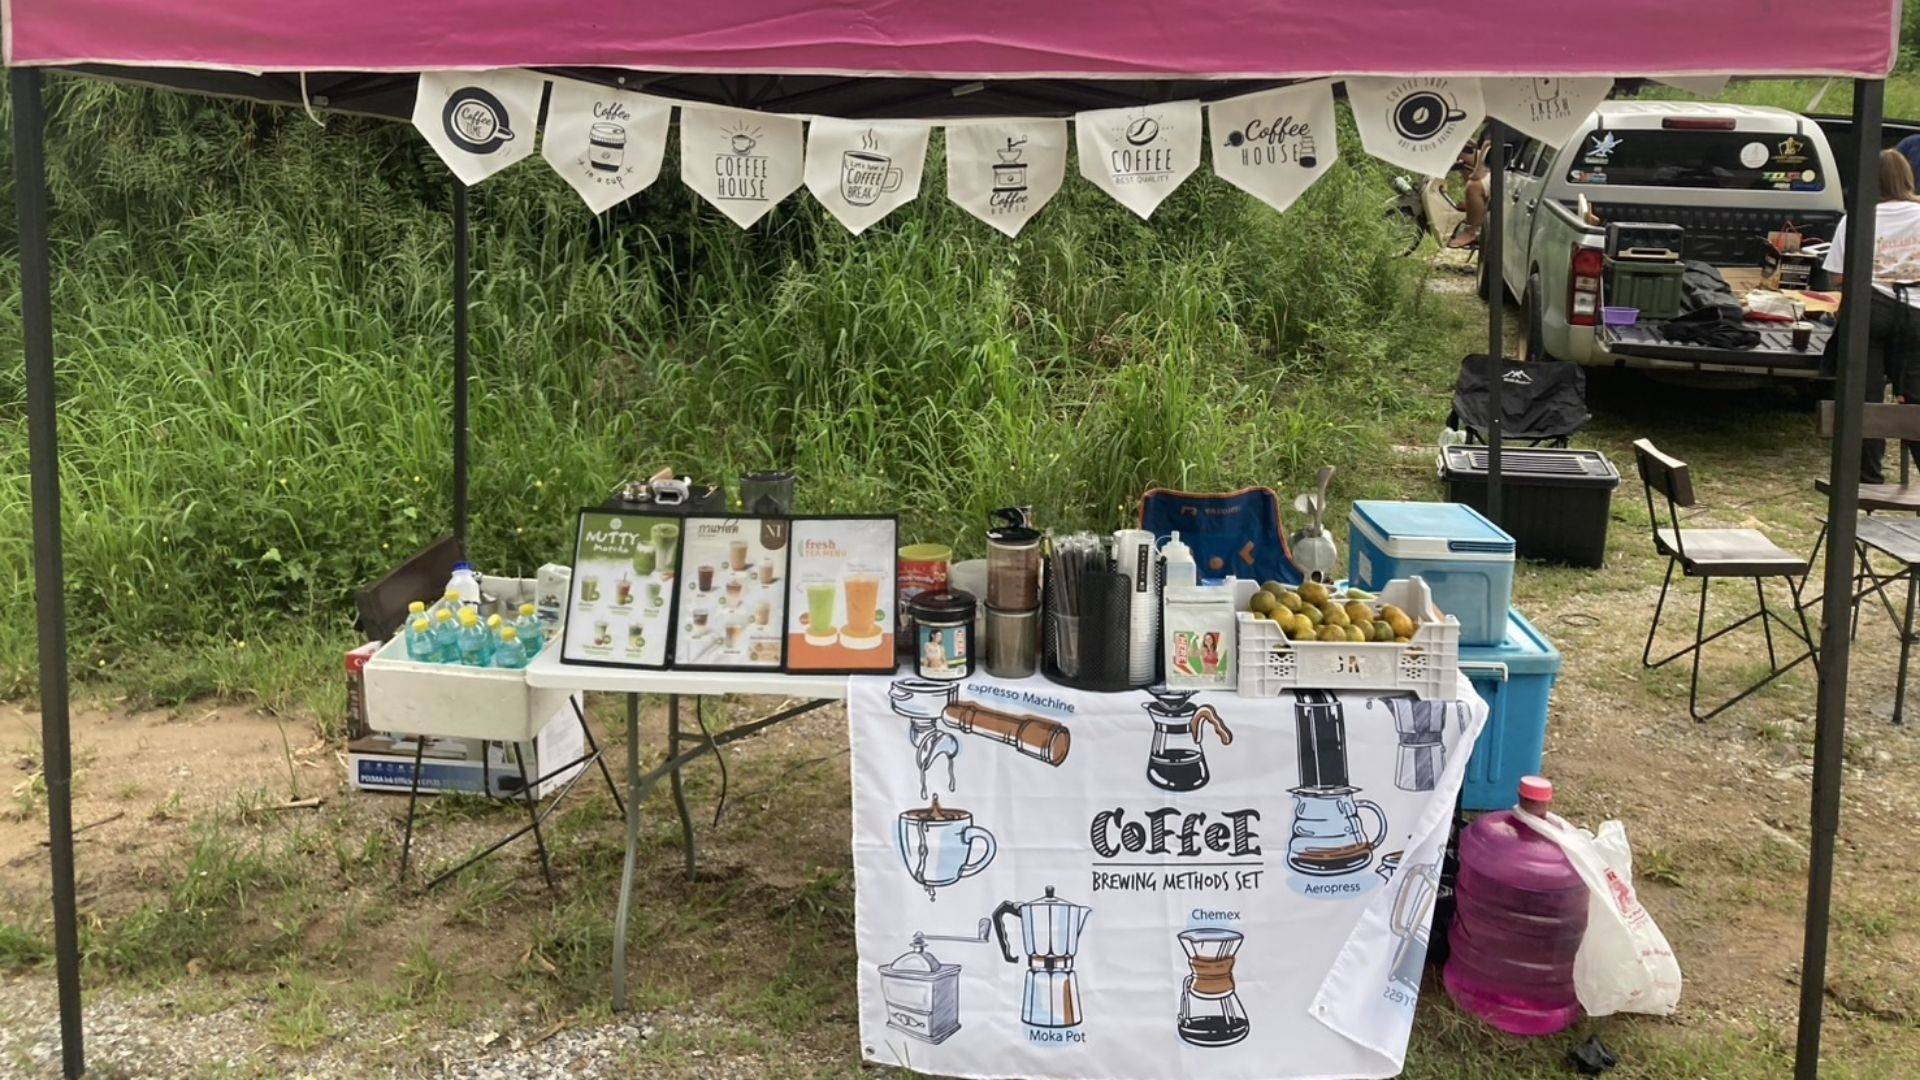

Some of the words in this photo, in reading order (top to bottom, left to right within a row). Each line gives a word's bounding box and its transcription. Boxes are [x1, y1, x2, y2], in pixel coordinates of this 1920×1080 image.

[461, 107, 492, 126] Coffee
[593, 101, 631, 120] Coffee
[1245, 116, 1311, 144] Coffee
[1112, 149, 1171, 172] COFFEE
[1242, 144, 1298, 166] HOUSE
[716, 156, 767, 178] COFFEE
[847, 168, 882, 186] COFFEE
[719, 177, 765, 198] HOUSE
[990, 191, 1028, 208] Coffee
[586, 531, 639, 545] NUTTY
[1022, 691, 1075, 713] Machine
[1092, 871, 1157, 891] BREWING
[1162, 871, 1229, 891] METHODS
[1234, 870, 1264, 891] SET
[1304, 883, 1361, 895] Aeropress
[1191, 908, 1240, 921] Chemex
[1029, 1029, 1063, 1042] Moka
[1065, 1030, 1087, 1043] Pot
